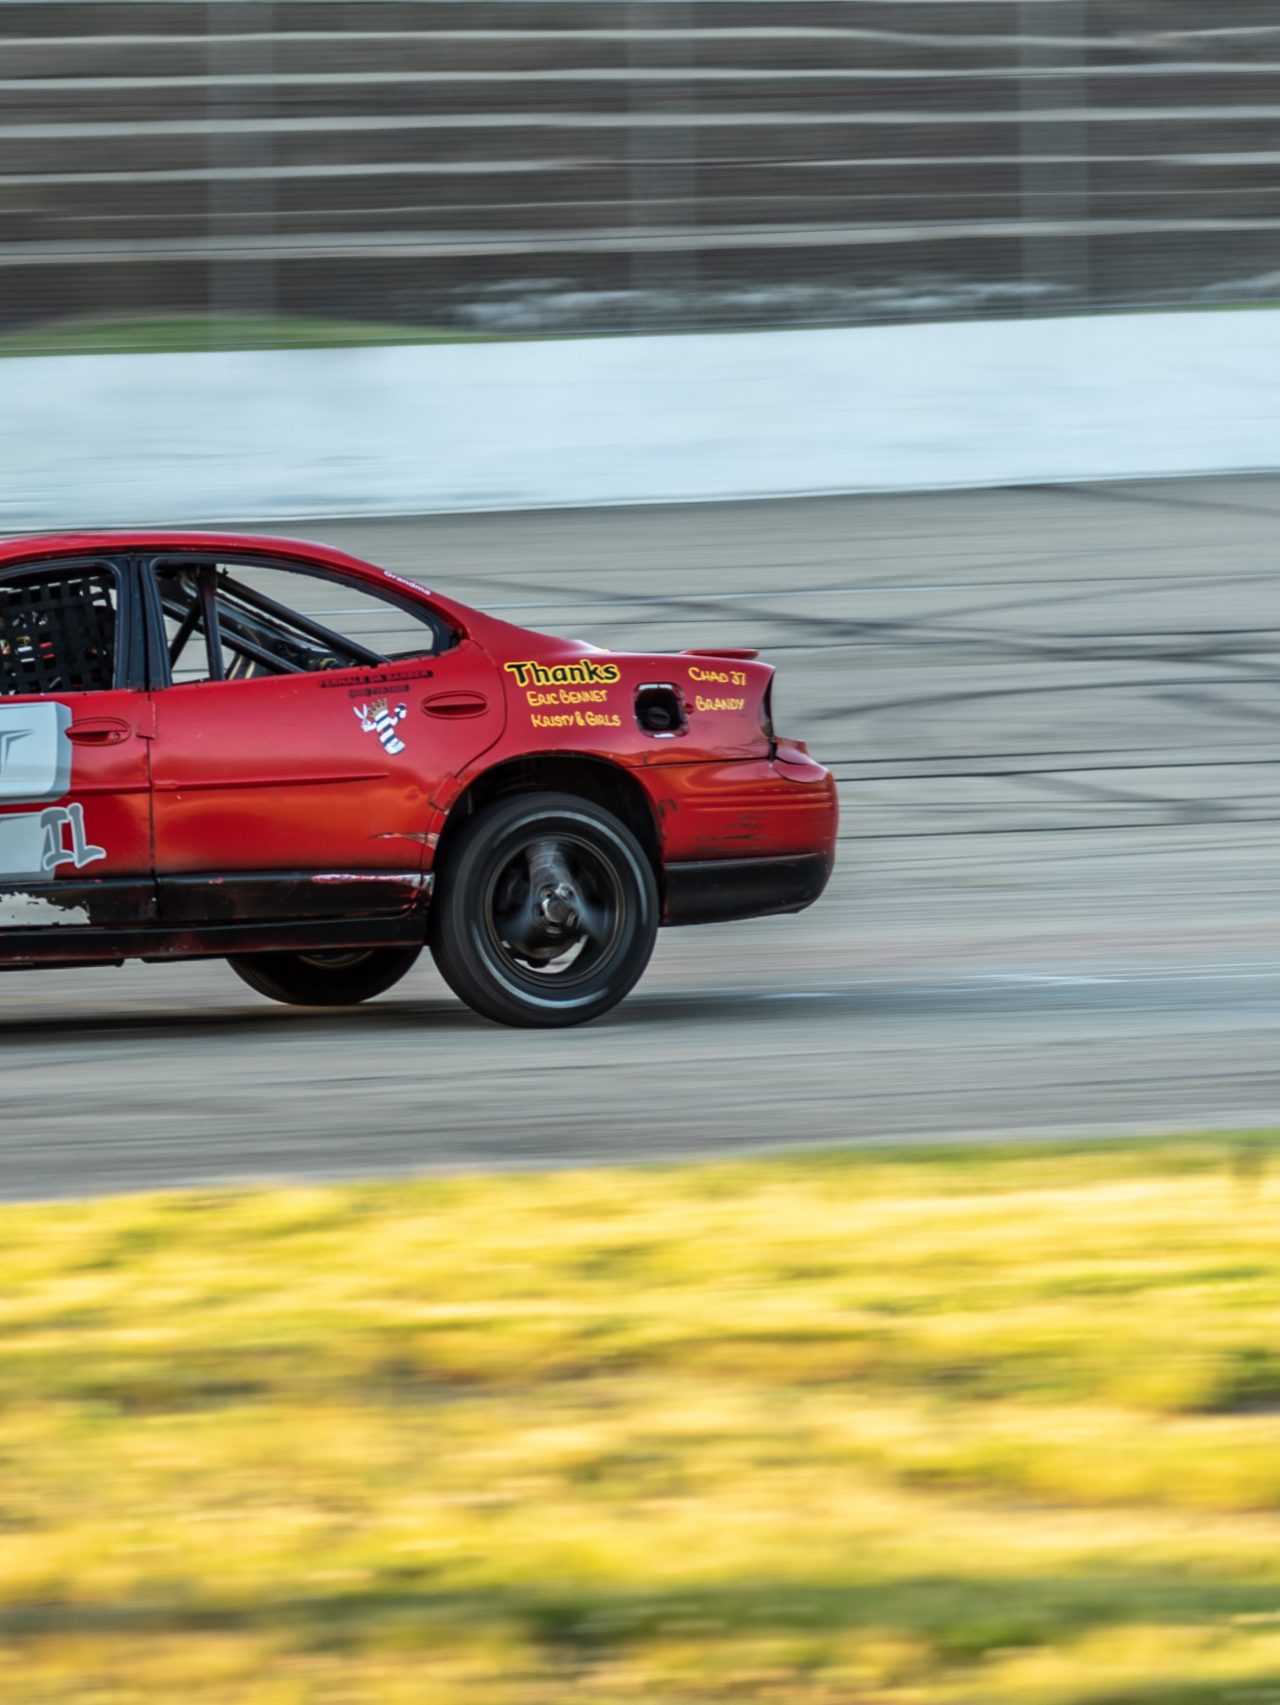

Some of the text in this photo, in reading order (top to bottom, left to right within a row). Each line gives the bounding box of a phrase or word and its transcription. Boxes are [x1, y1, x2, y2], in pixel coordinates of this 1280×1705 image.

[504, 660, 620, 687] Thanks
[688, 667, 746, 686] CHAD 37
[526, 689, 607, 706] ERIC BENNET
[696, 695, 744, 711] BRANDY
[531, 711, 621, 727] KRISTY & GIRLS
[40, 803, 106, 870] IL
